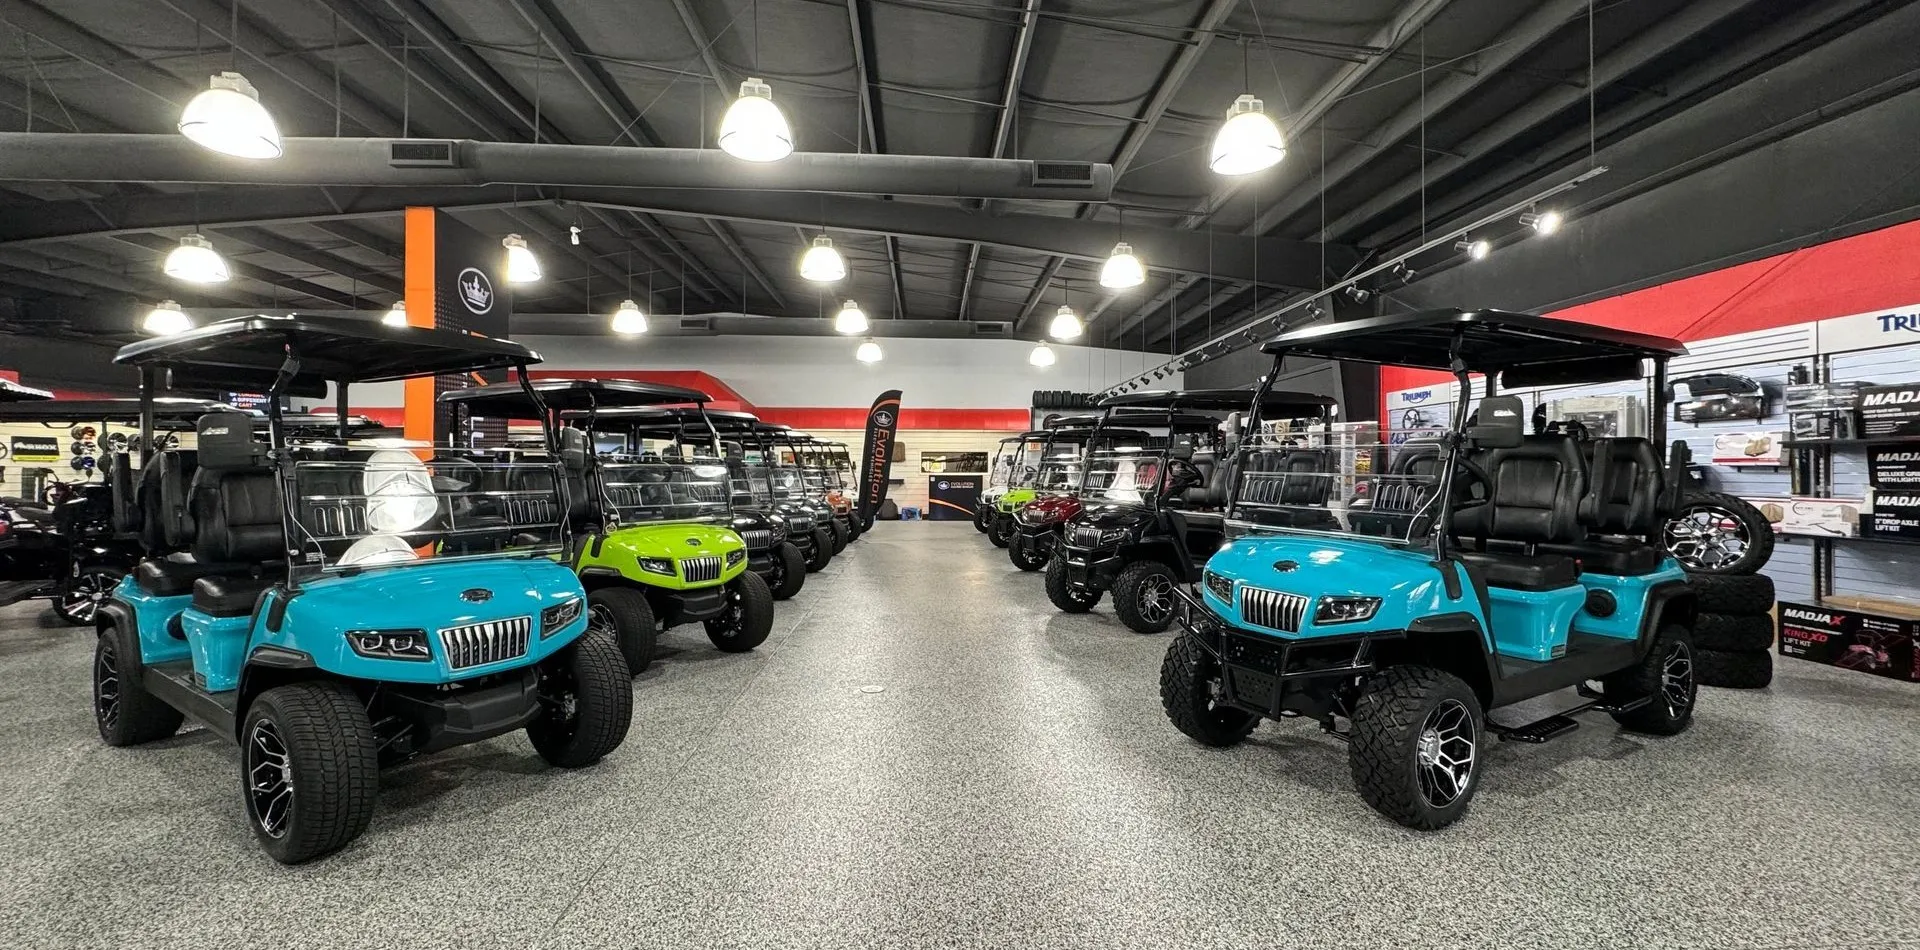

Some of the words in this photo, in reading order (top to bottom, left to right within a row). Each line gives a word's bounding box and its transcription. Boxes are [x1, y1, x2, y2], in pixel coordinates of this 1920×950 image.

[1877, 313, 1920, 332] TRI
[1401, 390, 1431, 403] TRIUMPH
[870, 428, 890, 504] Evolution
[1901, 519, 1919, 527] AXLE
[1784, 608, 1846, 626] MADJAX
[1784, 628, 1808, 639] KING
[1784, 637, 1799, 645] LIFT
[1799, 639, 1812, 647] KIT
